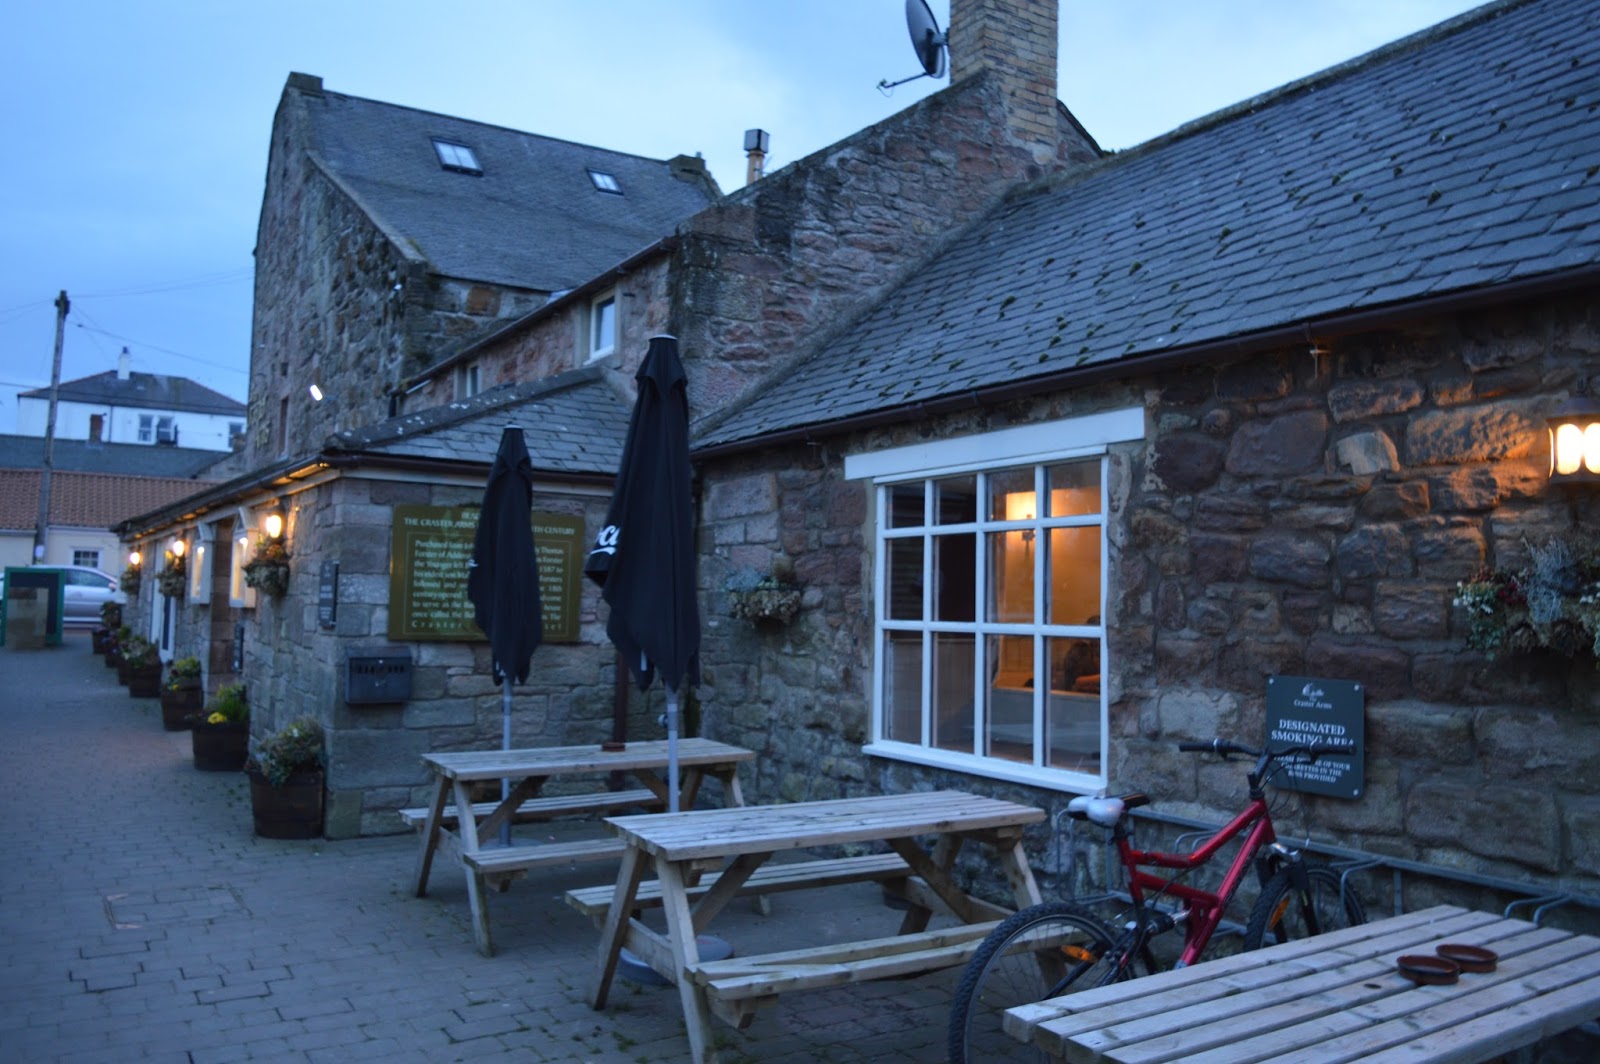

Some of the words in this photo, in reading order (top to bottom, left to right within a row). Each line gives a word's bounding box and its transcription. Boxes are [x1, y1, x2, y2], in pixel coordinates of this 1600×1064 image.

[404, 517, 419, 526] THE
[420, 518, 454, 528] CRASTER
[455, 520, 476, 529] ARMS
[544, 527, 576, 535] CENTURY
[1293, 699, 1315, 708] Craster
[1315, 701, 1333, 710] Arms
[1279, 719, 1346, 736] DESIGNATED
[1332, 761, 1351, 771] YOUR
